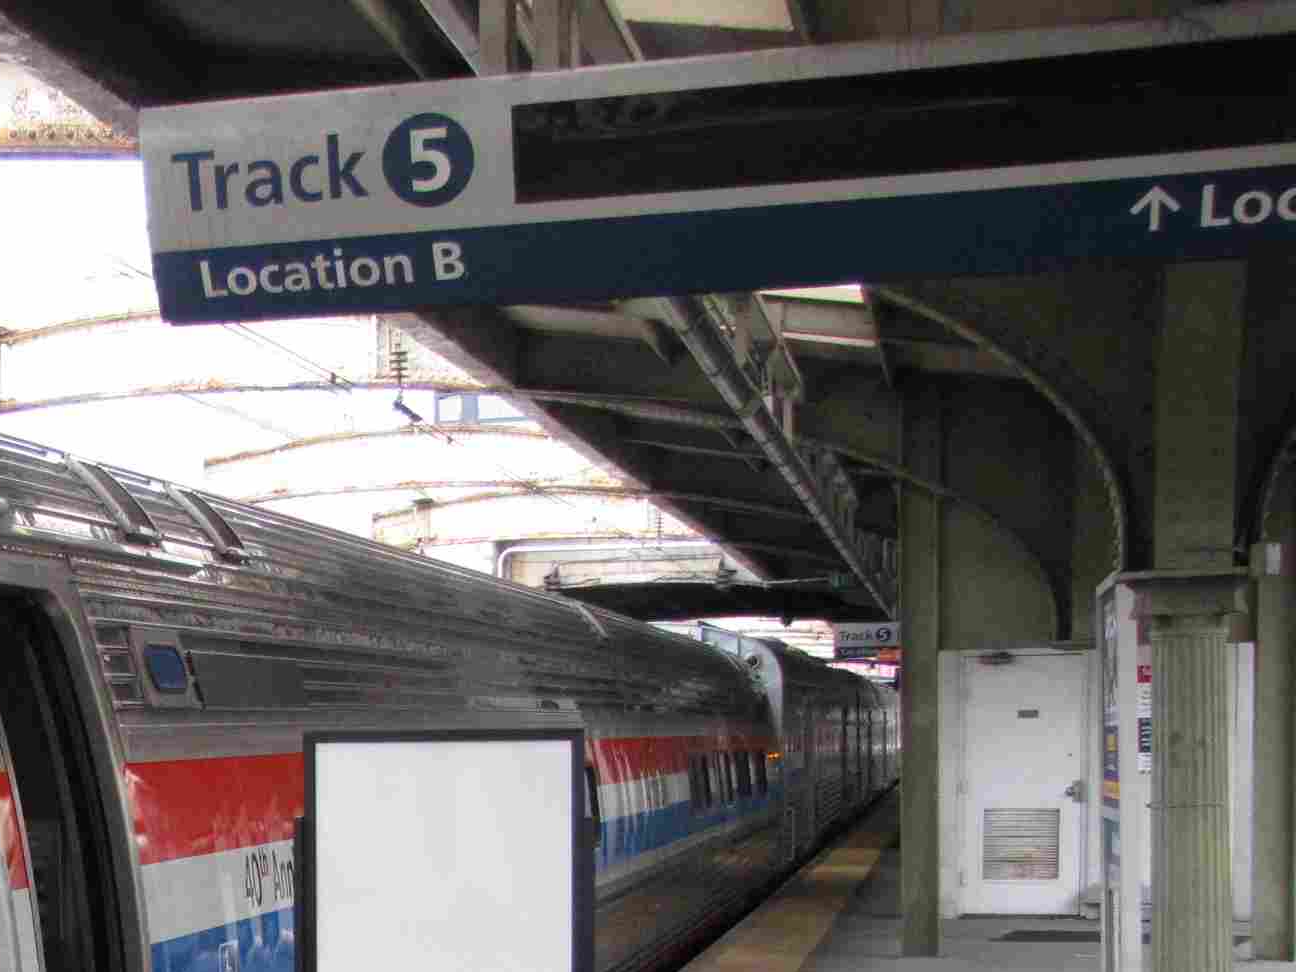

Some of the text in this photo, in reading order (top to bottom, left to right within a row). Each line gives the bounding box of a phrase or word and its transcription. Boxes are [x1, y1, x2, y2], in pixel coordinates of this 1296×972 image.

[171, 126, 452, 212] Track 5
[199, 240, 466, 299] Location B
[839, 630, 874, 641] Track
